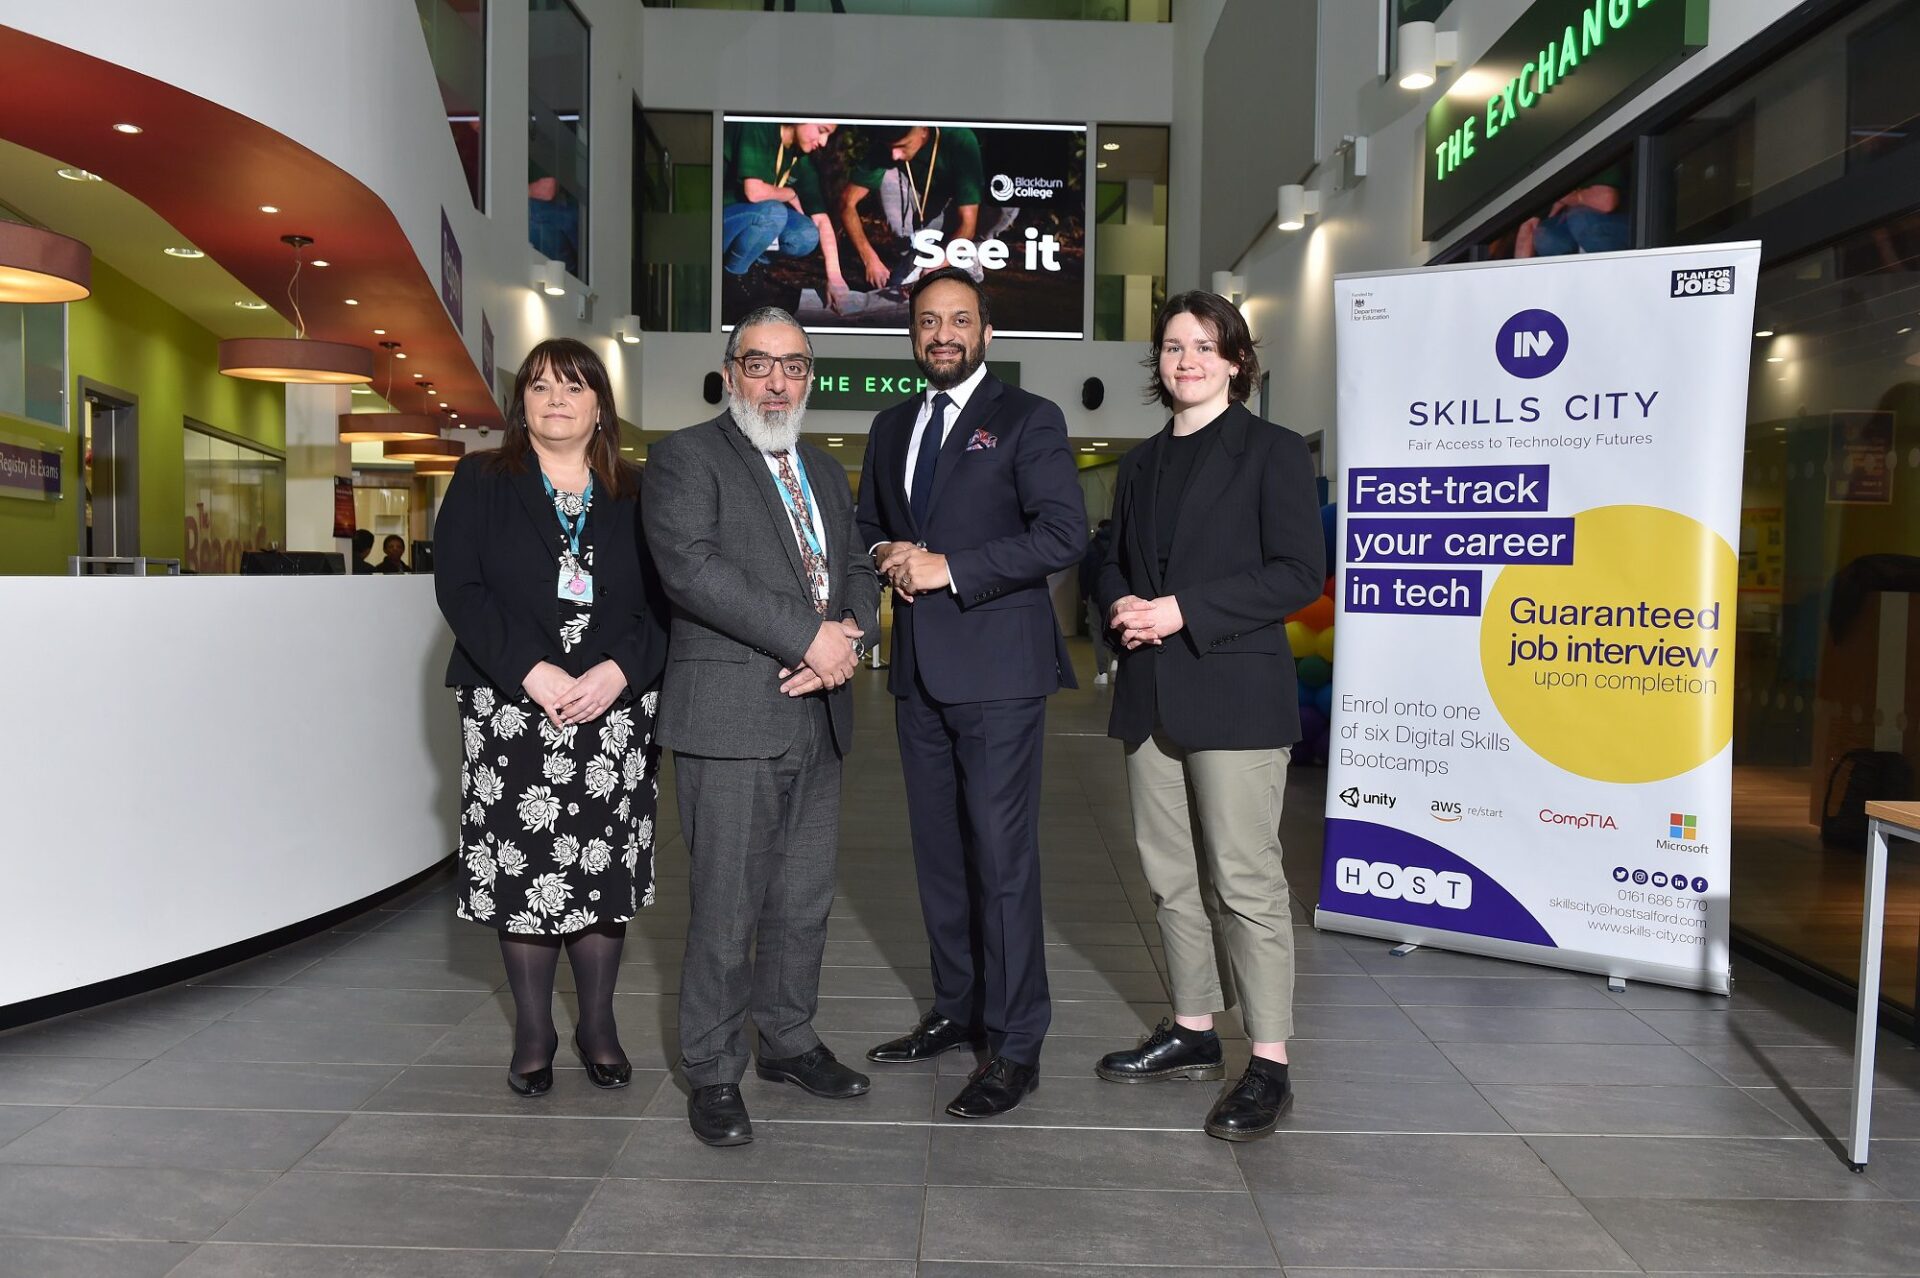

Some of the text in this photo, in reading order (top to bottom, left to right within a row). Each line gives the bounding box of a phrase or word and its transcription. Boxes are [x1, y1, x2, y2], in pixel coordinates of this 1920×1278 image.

[1436, 0, 1651, 180] THE EXCHANG
[1014, 177, 1063, 189] Blackburn
[1014, 187, 1054, 200] College
[912, 226, 1062, 272] See it
[1673, 277, 1731, 296] JOBS
[1676, 269, 1730, 281] PLAN FOR
[813, 375, 850, 392] HE
[1408, 391, 1660, 427] SKILLS CITY
[1408, 432, 1653, 451] Fair Access to Technology Futures
[30, 459, 36, 475] &
[38, 460, 59, 479] Exams
[1355, 473, 1540, 507] Fast-track
[1353, 532, 1567, 562] your career
[1351, 575, 1471, 609] in tech
[1509, 596, 1720, 631] Guaranteed
[1507, 632, 1719, 670] job interview
[1533, 671, 1718, 696] upon completion
[1341, 694, 1482, 722] Enrol onto one
[1340, 722, 1511, 753] of six Digital Skills
[1339, 748, 1450, 777] Bootcamps
[1362, 792, 1397, 809] unity
[1430, 800, 1504, 819] aws re/start
[1539, 808, 1616, 830] CompTIA
[1656, 839, 1709, 855] Microsoft
[1345, 866, 1462, 900] HOST
[1549, 897, 1708, 928] skillscity@hostsalford.com
[1617, 888, 1708, 912] 0161 686 5770
[1587, 920, 1707, 945] www.skills-city.com
